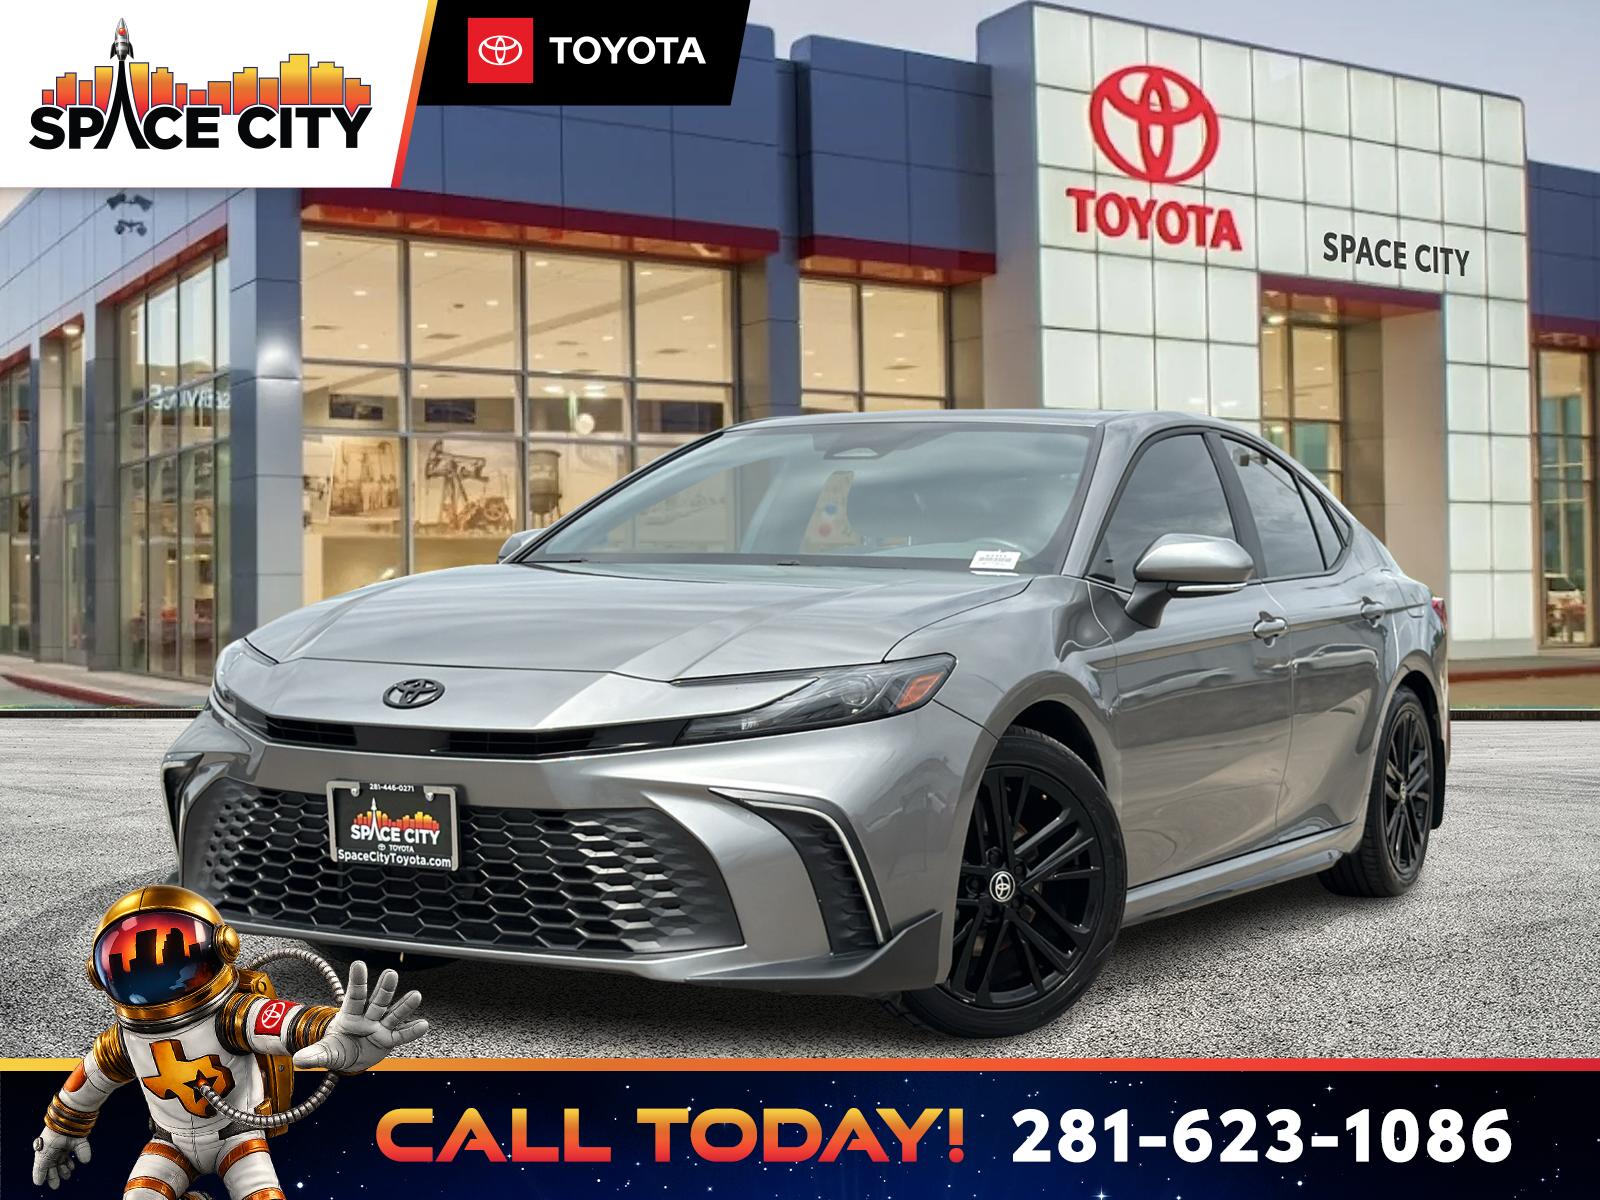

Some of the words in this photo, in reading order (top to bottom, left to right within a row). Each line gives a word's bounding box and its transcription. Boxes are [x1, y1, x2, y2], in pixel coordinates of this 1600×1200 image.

[1066, 187, 1242, 252] TOYOTA
[1323, 231, 1407, 271] SPACE
[1414, 244, 1471, 277] CITY
[350, 823, 401, 843] SPACE
[404, 828, 441, 845] CITY
[337, 849, 452, 868] SpaceCityToyota.com
[389, 844, 415, 853] TOYOTA
